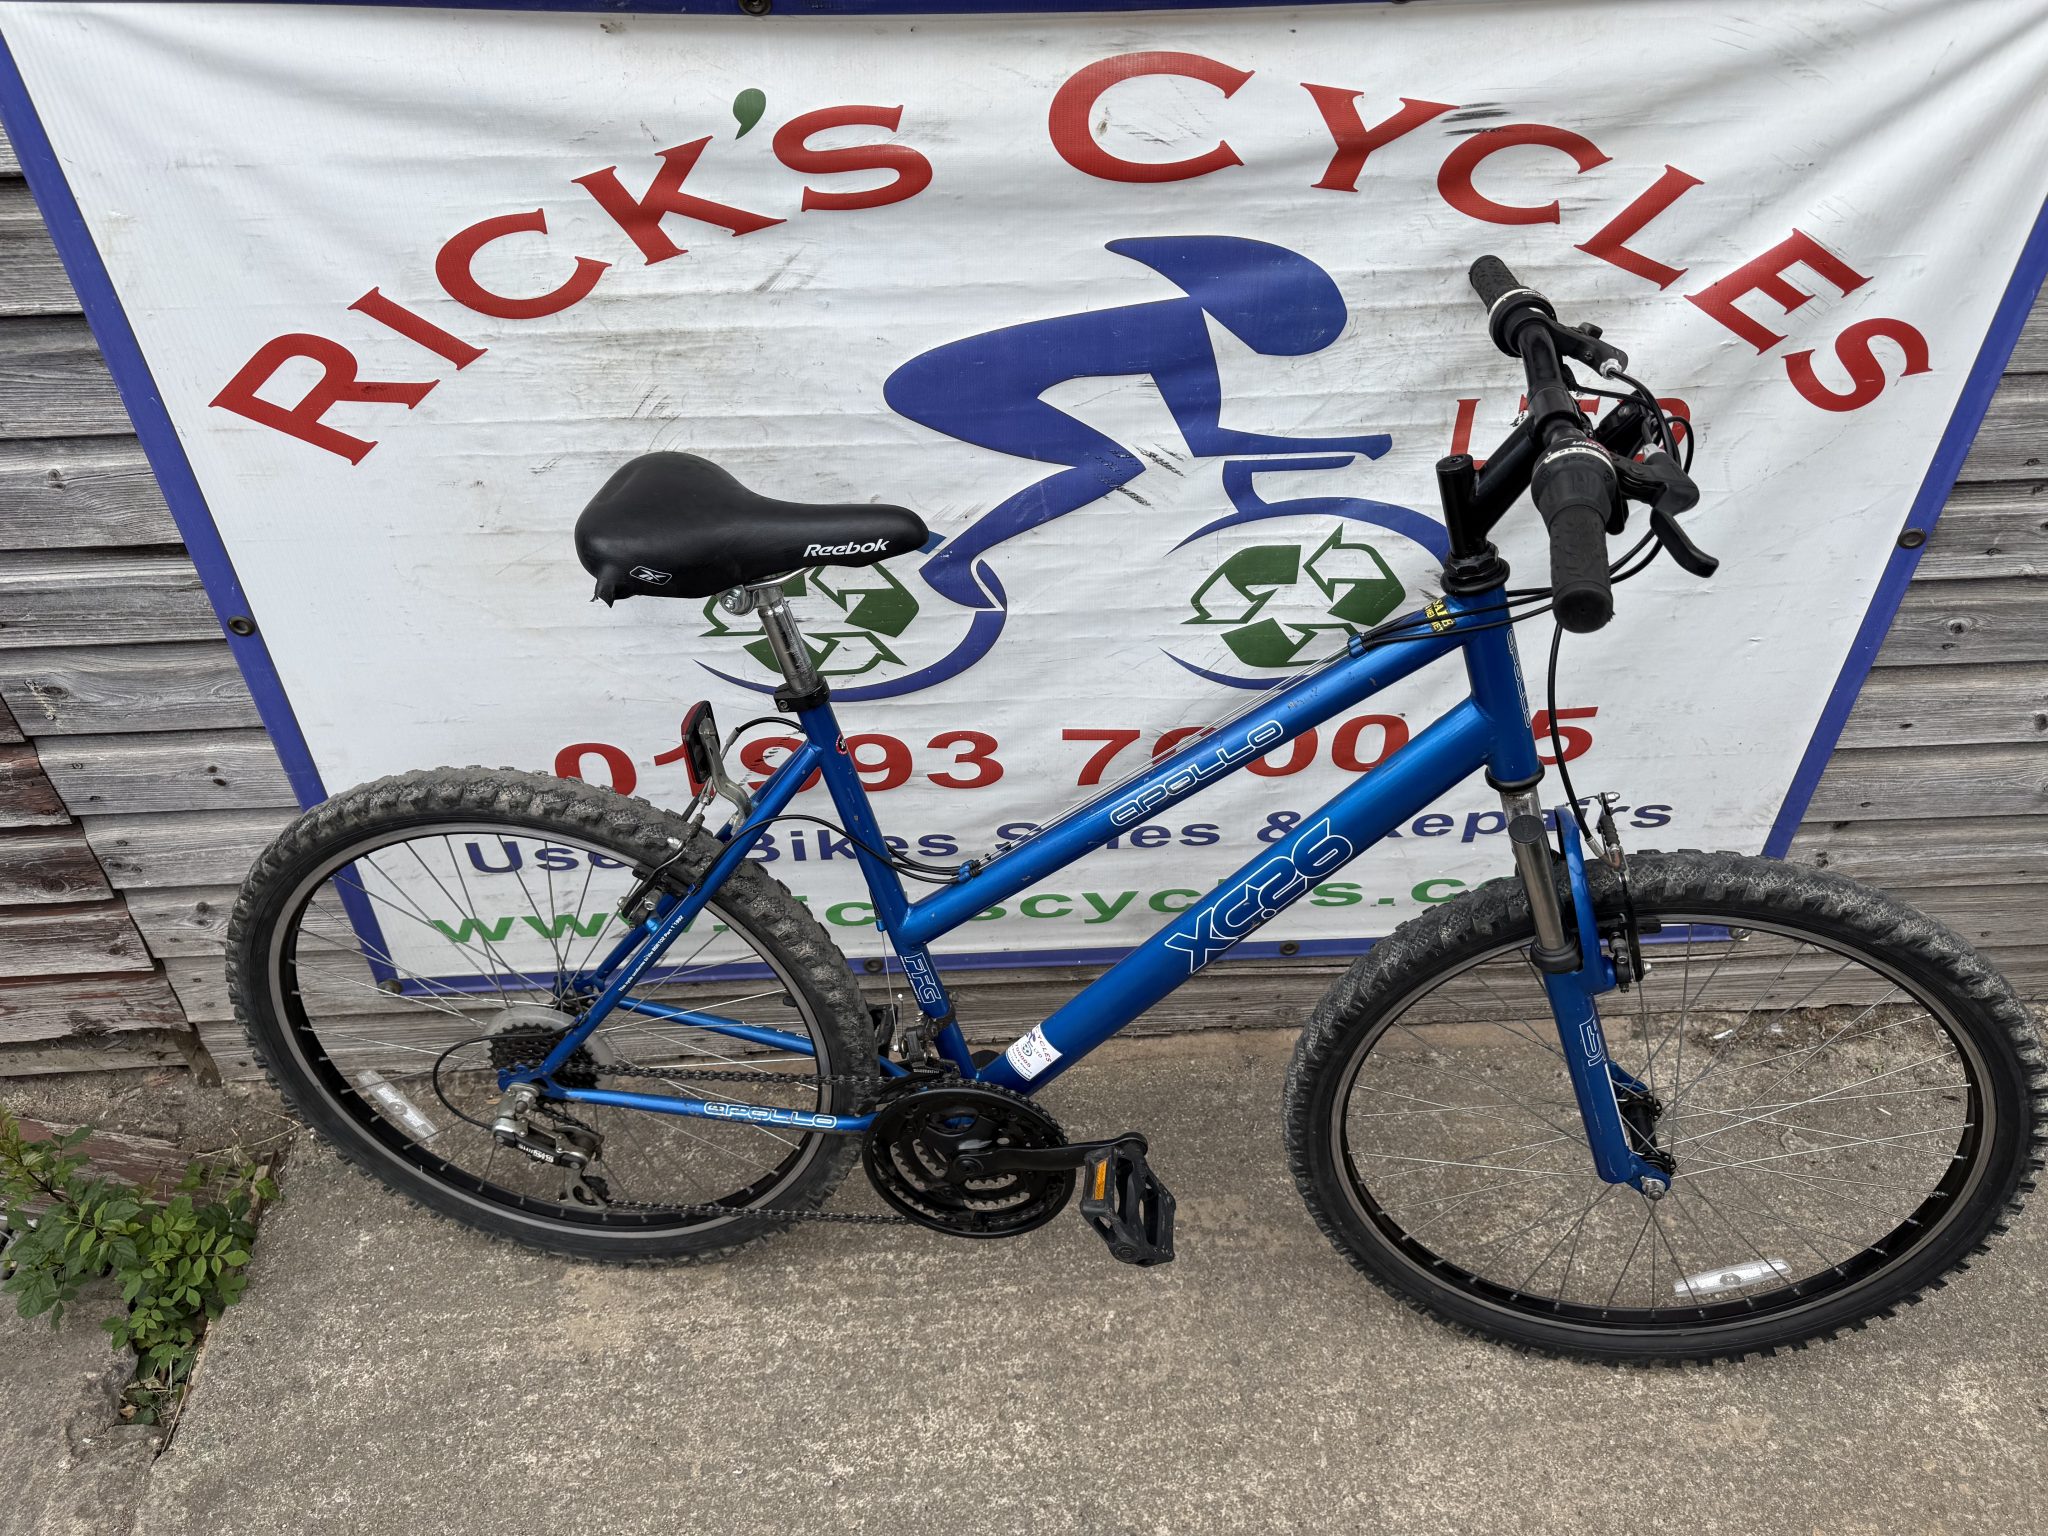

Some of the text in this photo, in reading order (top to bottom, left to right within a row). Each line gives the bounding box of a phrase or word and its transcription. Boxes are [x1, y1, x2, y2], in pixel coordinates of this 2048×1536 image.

[208, 51, 1933, 466] RICK'S CYCLES
[803, 538, 890, 558] Reebok
[1109, 719, 1284, 827] APOLLO
[1256, 810, 1301, 843] &
[704, 1101, 838, 1129] APOLLO
